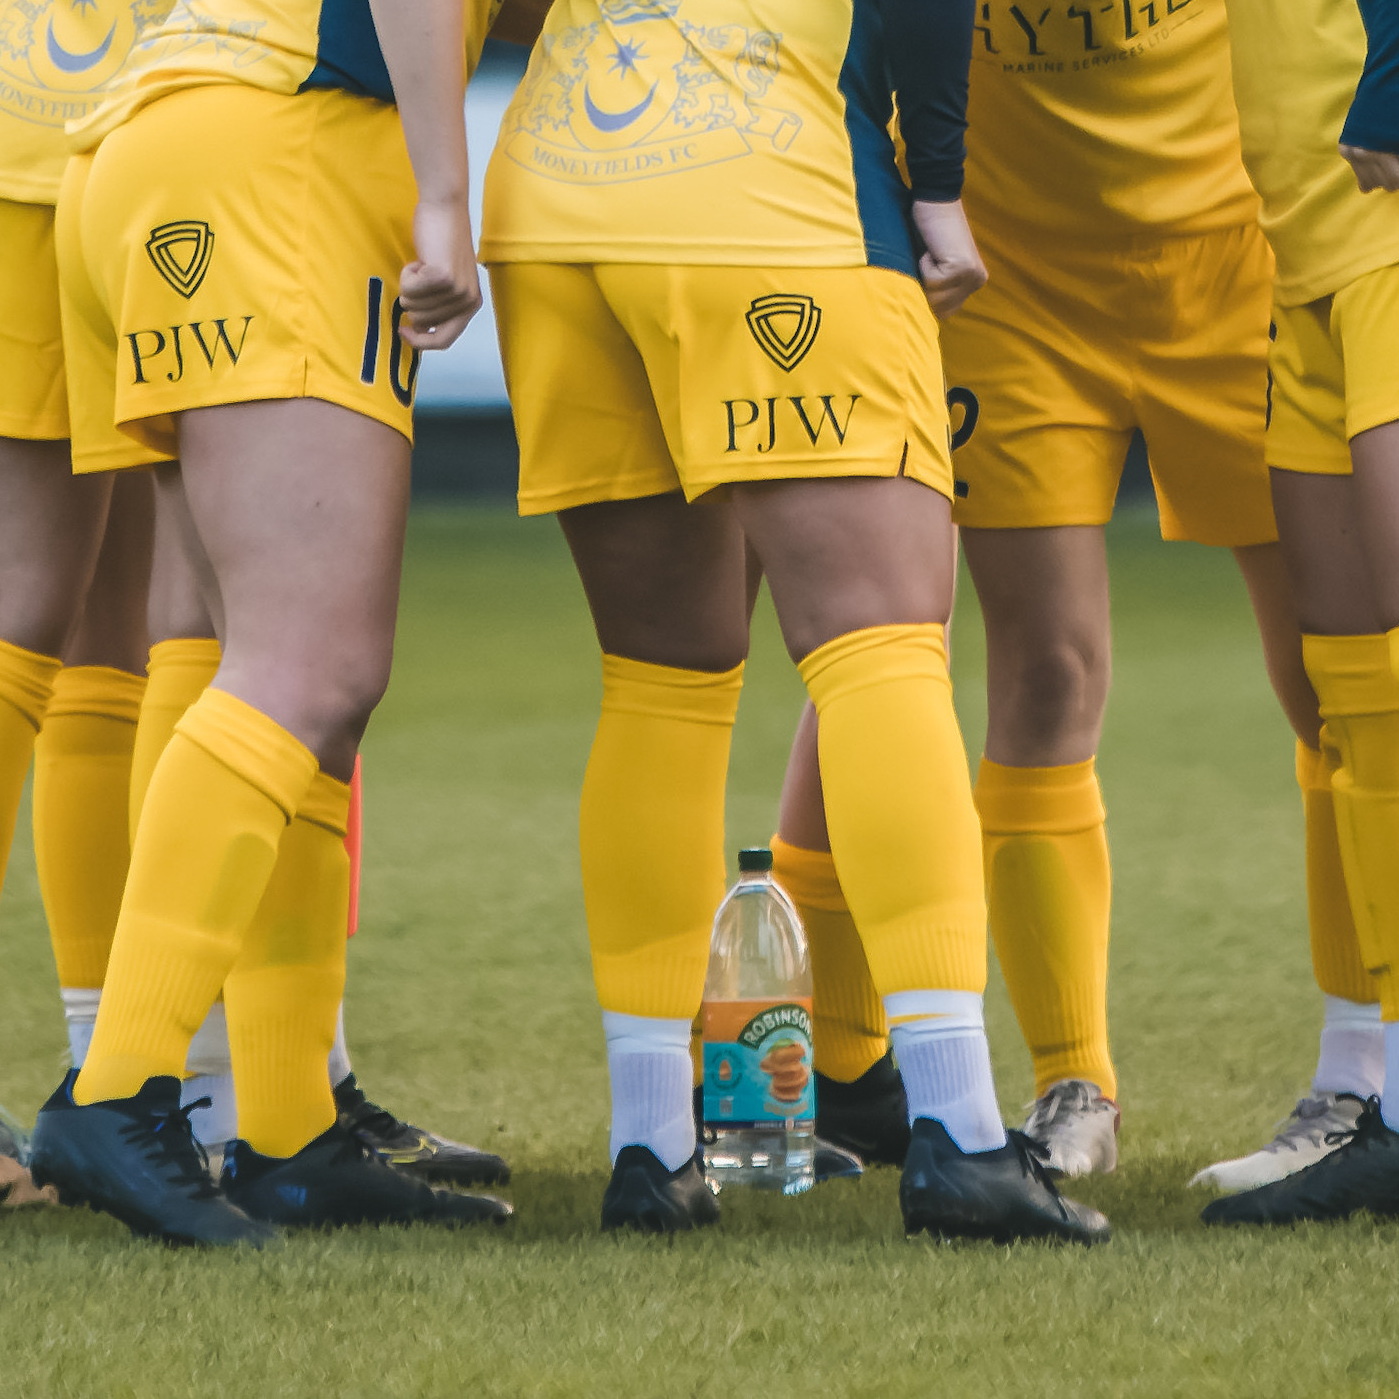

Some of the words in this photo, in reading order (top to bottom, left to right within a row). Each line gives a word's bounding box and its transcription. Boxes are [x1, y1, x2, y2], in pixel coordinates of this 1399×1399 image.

[531, 145, 664, 176] MONEYFIELDS
[669, 142, 699, 164] FC
[124, 315, 256, 385] PJW
[721, 394, 863, 453] PJW
